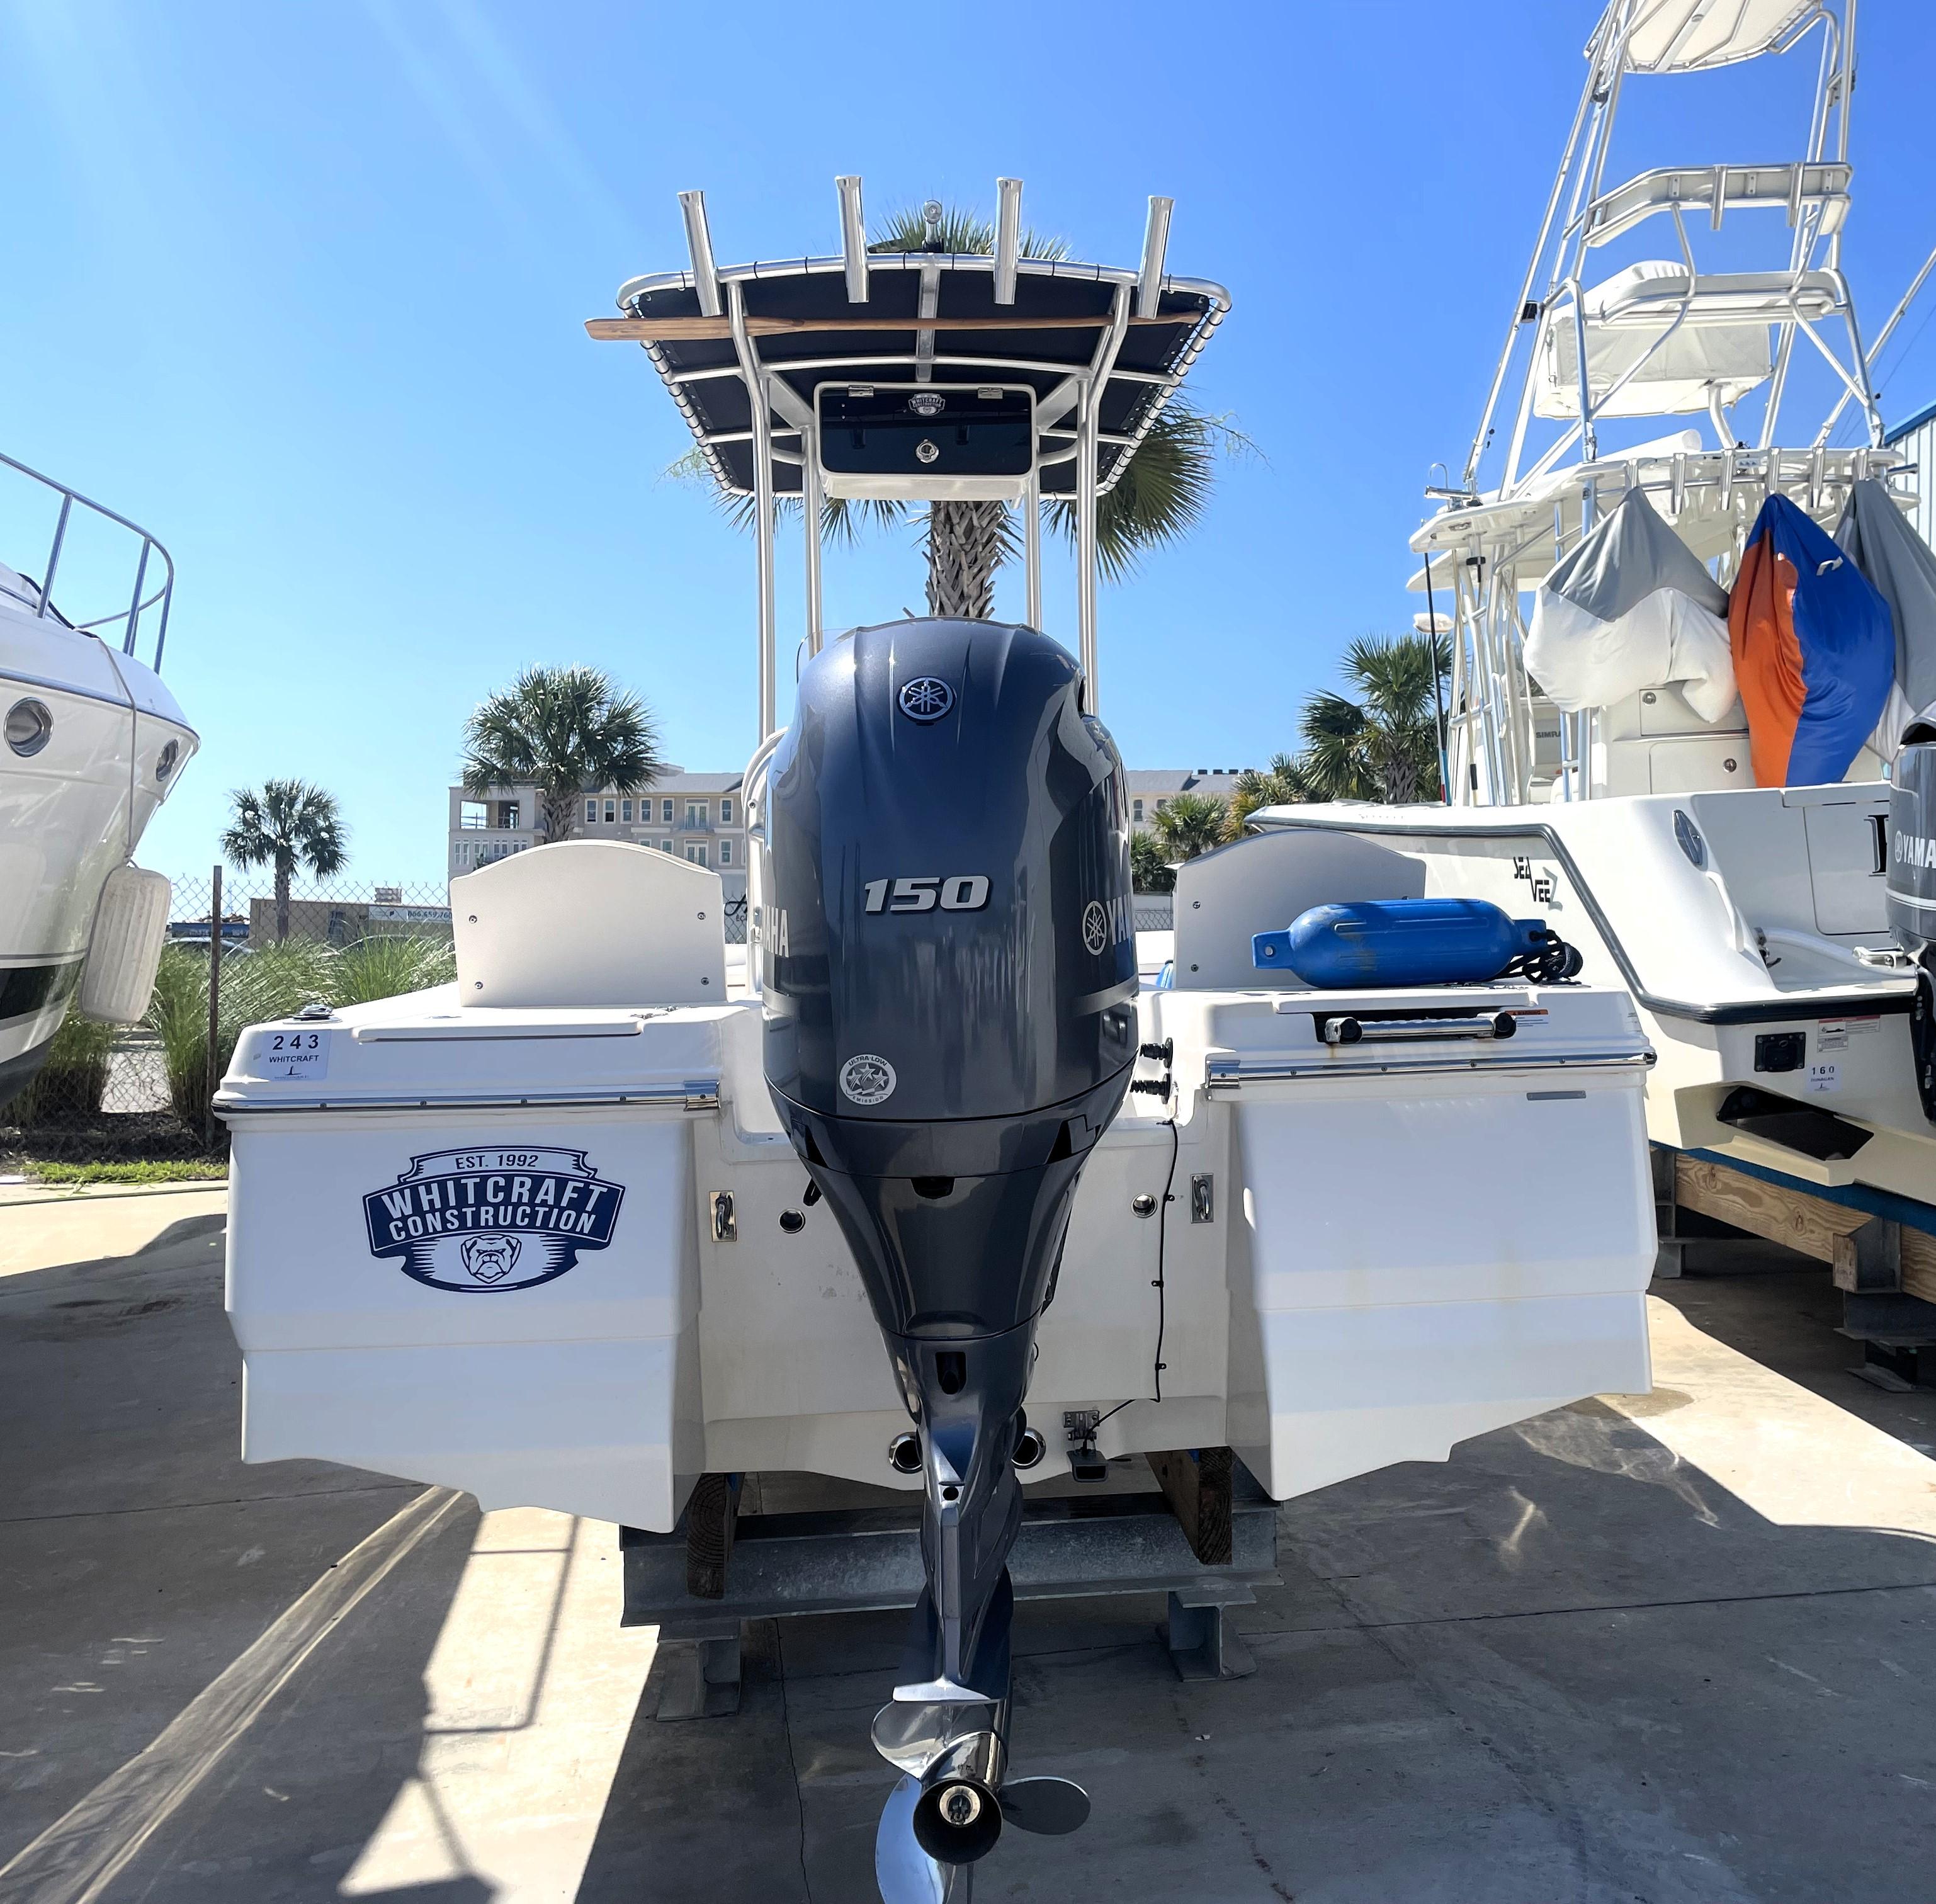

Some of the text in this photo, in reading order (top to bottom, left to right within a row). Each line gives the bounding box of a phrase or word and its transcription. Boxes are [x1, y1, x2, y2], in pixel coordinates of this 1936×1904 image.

[1536, 730, 1561, 739] SIMR
[1903, 834, 1936, 869] YAMA
[864, 875, 989, 912] 150
[763, 904, 790, 958] AHA
[269, 1055, 319, 1063] WHITCRAFT
[455, 1154, 539, 1170] EST. 1992
[381, 1176, 608, 1219] WHITCRAFT
[388, 1206, 596, 1241] CONSTRUCTION
